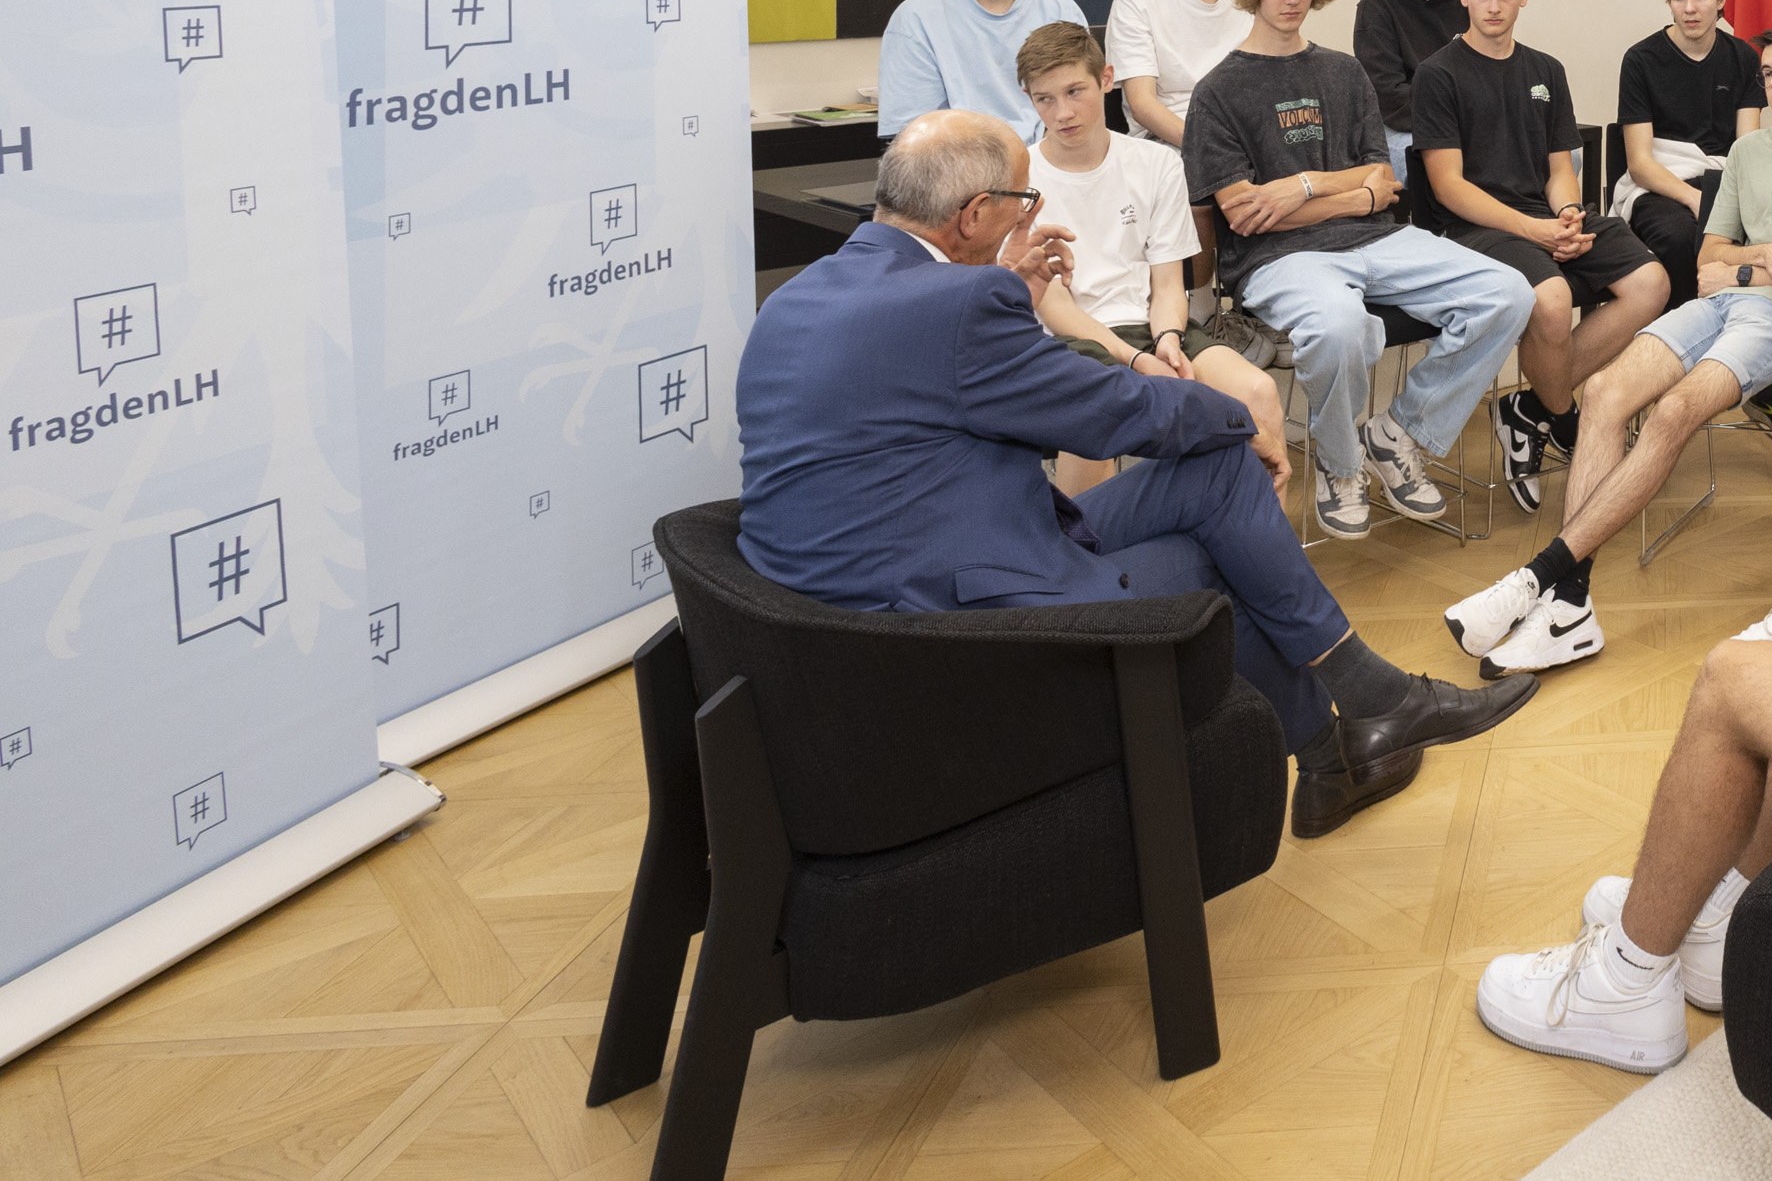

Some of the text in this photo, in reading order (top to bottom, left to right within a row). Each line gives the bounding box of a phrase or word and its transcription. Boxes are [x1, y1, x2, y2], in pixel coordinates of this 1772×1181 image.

[346, 68, 572, 131] fragdenLH
[547, 247, 673, 298] fragdenLH
[8, 368, 221, 451] fragdenLH
[392, 415, 500, 461] fragdenLH
